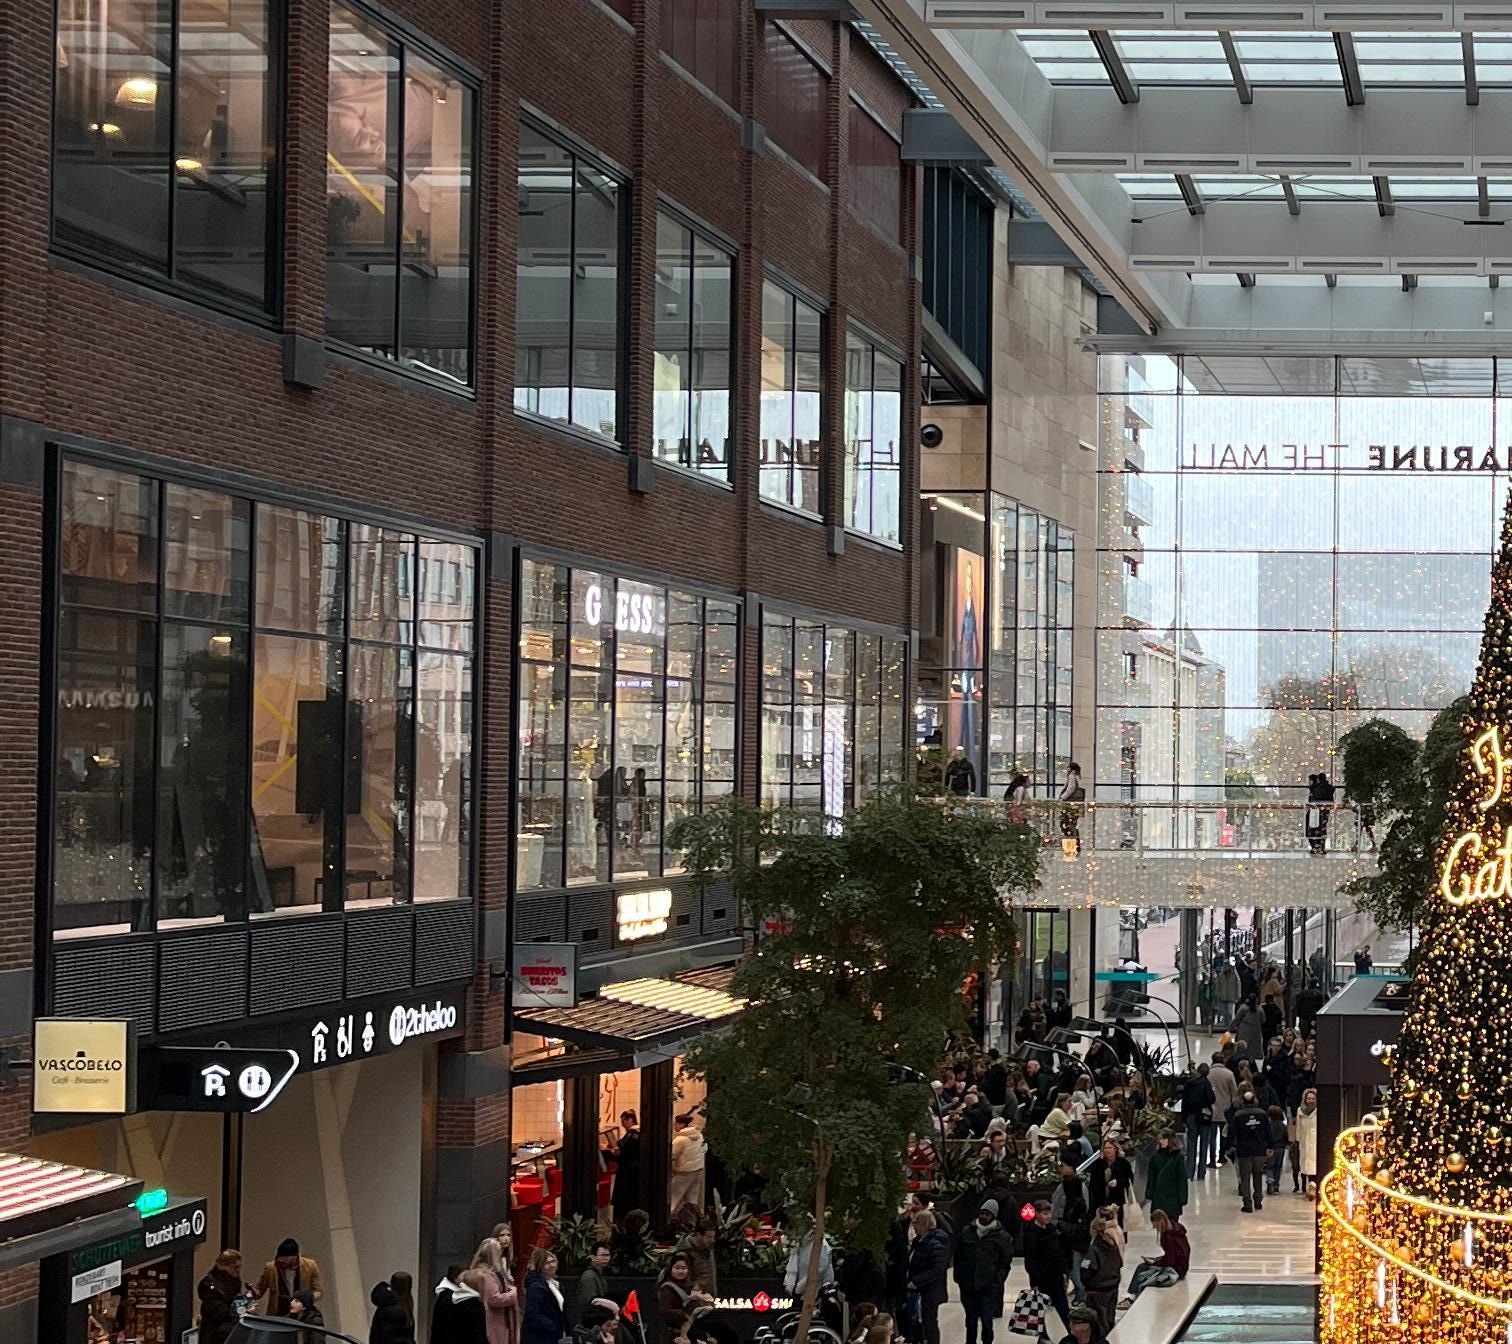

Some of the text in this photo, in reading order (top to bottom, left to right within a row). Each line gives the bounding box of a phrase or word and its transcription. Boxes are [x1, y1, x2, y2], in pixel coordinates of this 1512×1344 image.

[585, 585, 653, 634] GESS
[529, 976, 559, 986] TACOS
[404, 1000, 457, 1037] 2theloo
[145, 1217, 191, 1248] tourist info
[713, 1297, 754, 1310] SALSA
